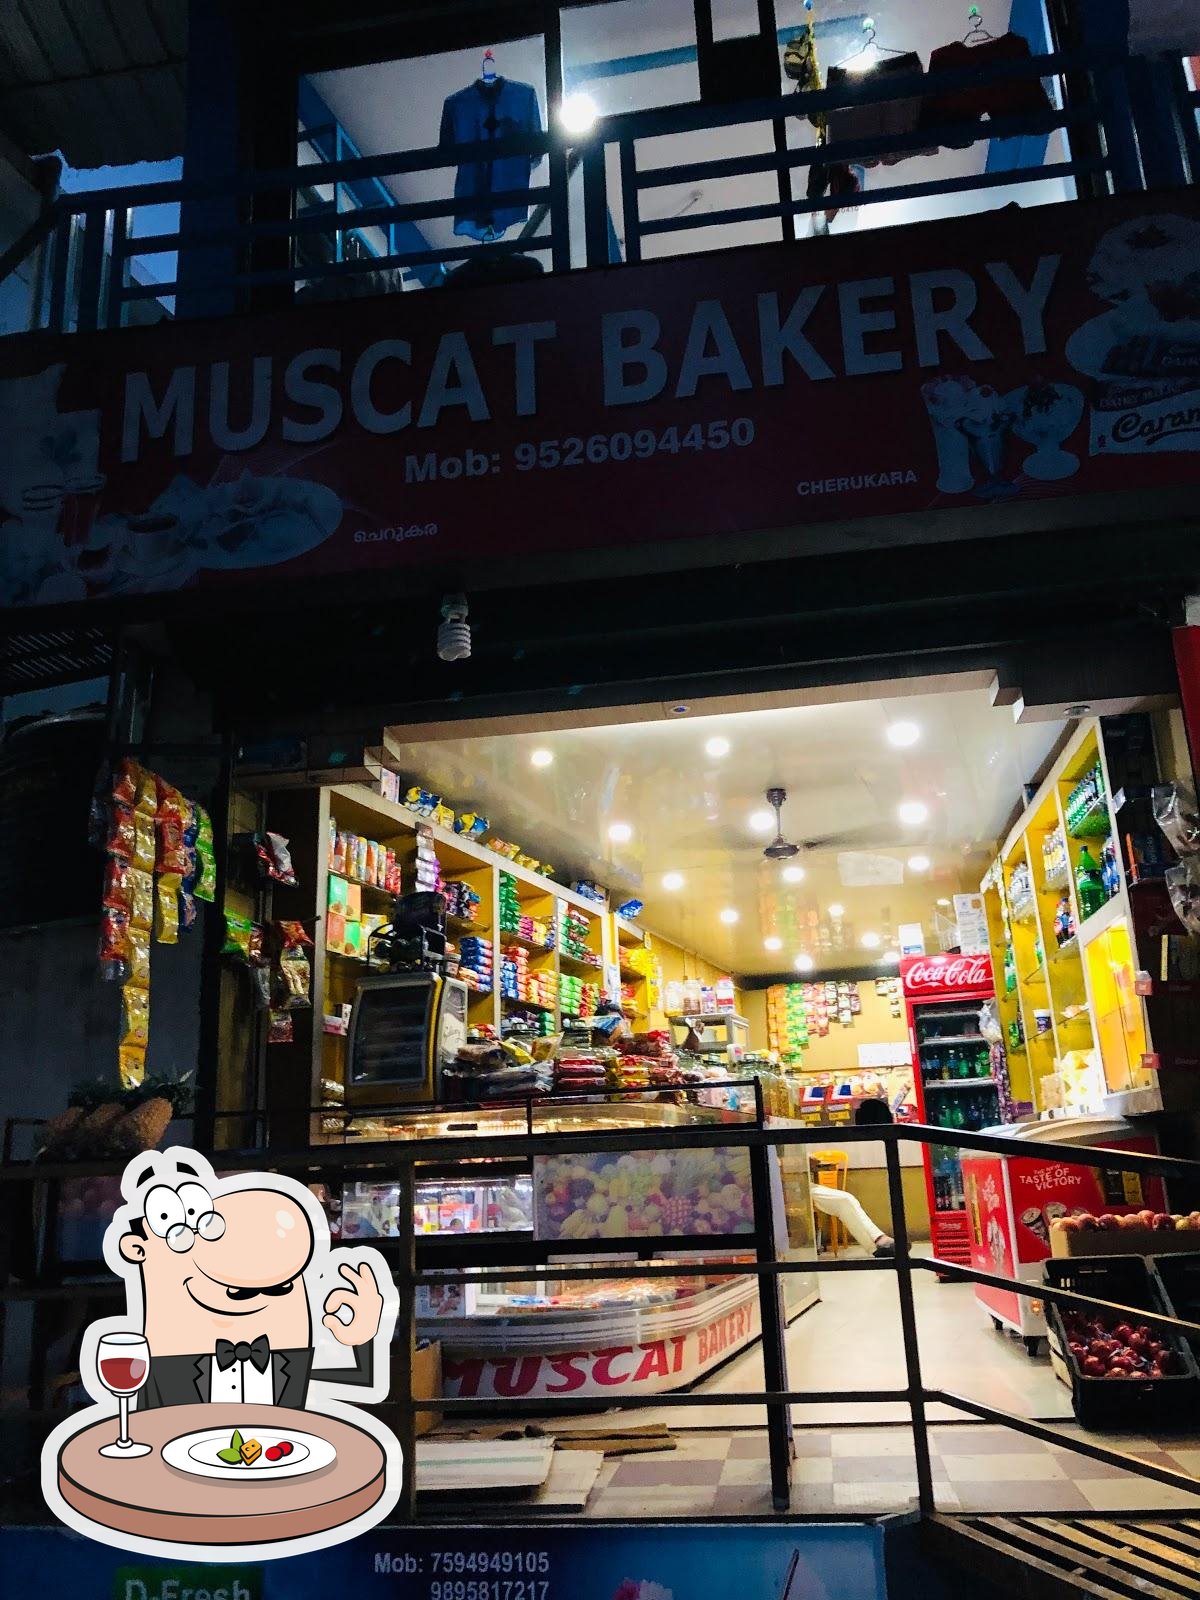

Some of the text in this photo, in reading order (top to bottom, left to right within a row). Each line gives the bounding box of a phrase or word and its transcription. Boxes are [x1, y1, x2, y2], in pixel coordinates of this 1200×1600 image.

[120, 253, 1062, 465] MUSCAT BAKERY
[404, 416, 756, 484] Mob: 9526094450
[796, 468, 918, 497] CHERUKARA
[353, 522, 439, 544] ചെറുകര
[904, 955, 993, 989] Coca-Cola
[1019, 1167, 1070, 1185] TASTE OF
[1035, 1176, 1082, 1191] VICTORY
[441, 1302, 755, 1398] MUSCAT BAKERY
[374, 1552, 550, 1575] Mob: 7594949105
[431, 1581, 550, 1600] 9895817217
